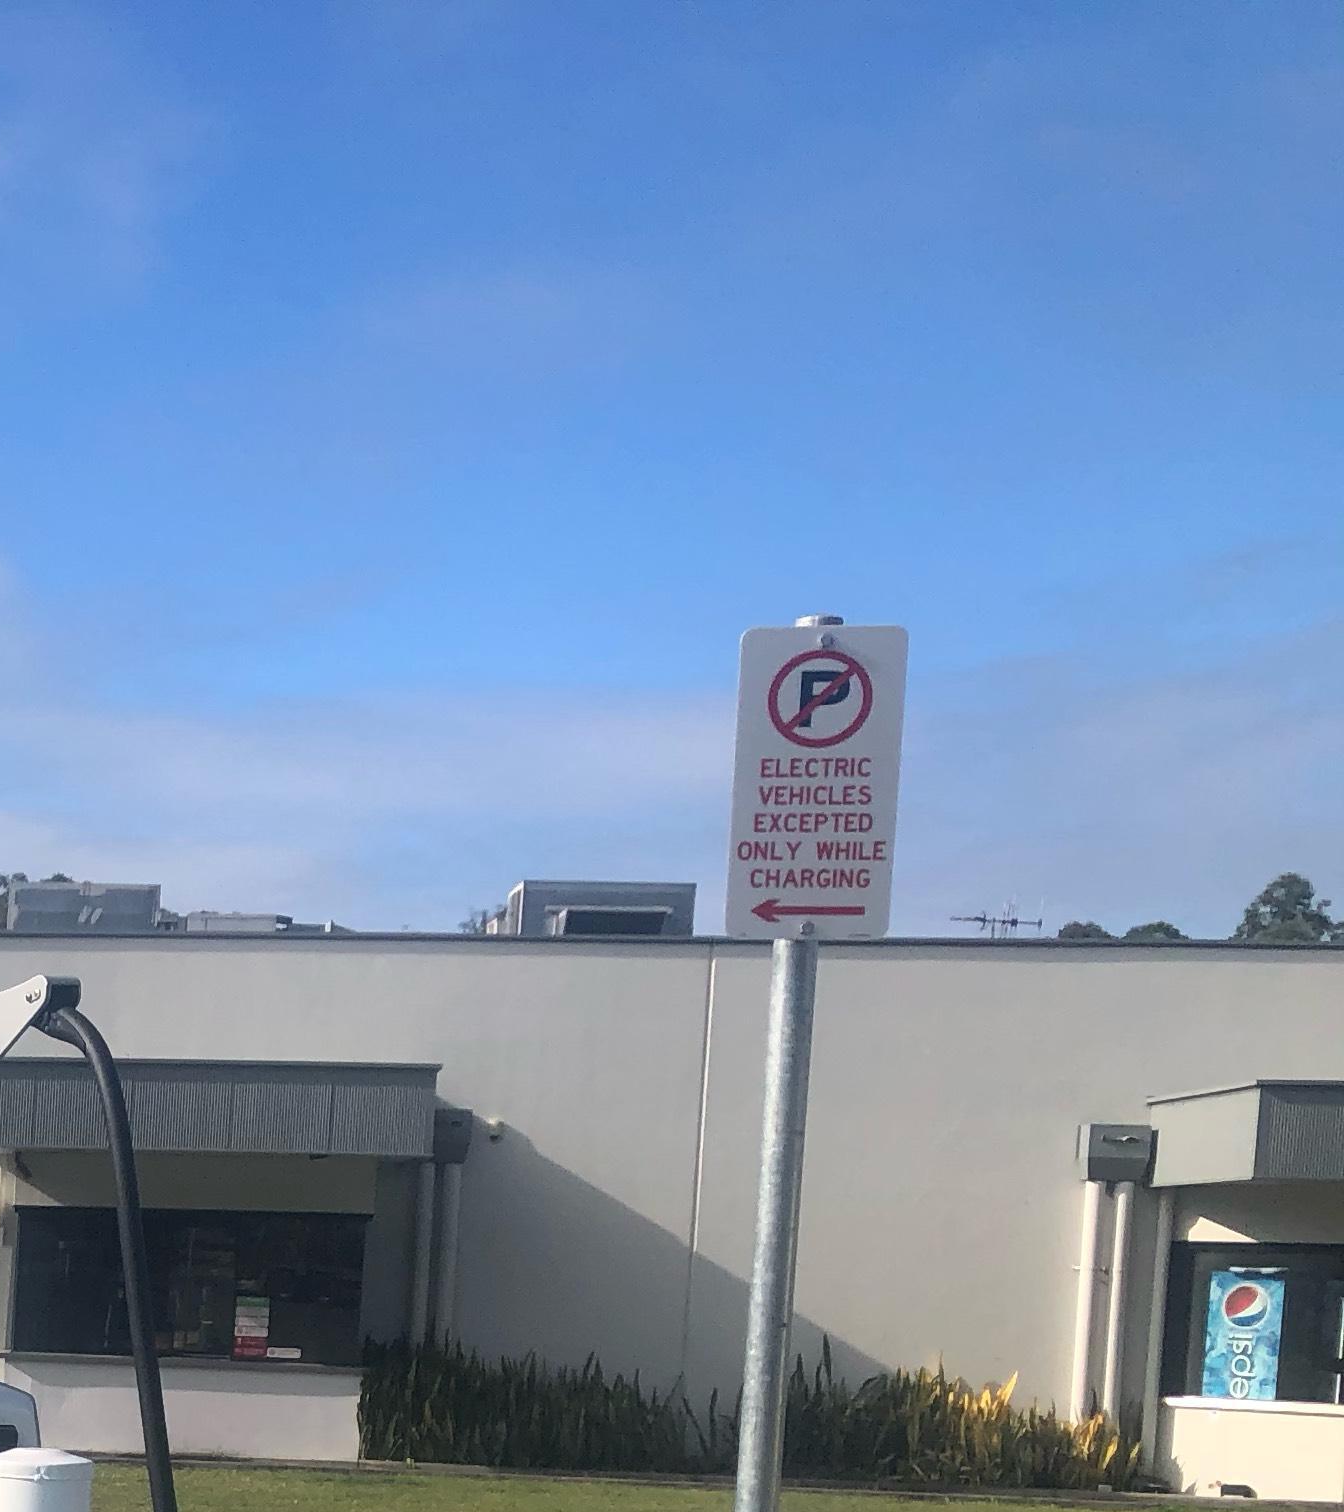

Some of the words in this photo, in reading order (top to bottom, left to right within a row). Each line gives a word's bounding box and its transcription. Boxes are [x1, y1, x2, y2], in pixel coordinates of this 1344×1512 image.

[760, 758, 872, 778] ELECTRIC
[758, 785, 872, 805] VEHICLES
[753, 812, 873, 833] EXCEPTED
[737, 841, 802, 861] ONLY
[816, 841, 887, 861] WHILE
[750, 868, 872, 889] CHARGING
[1228, 1333, 1257, 1399] epsi
